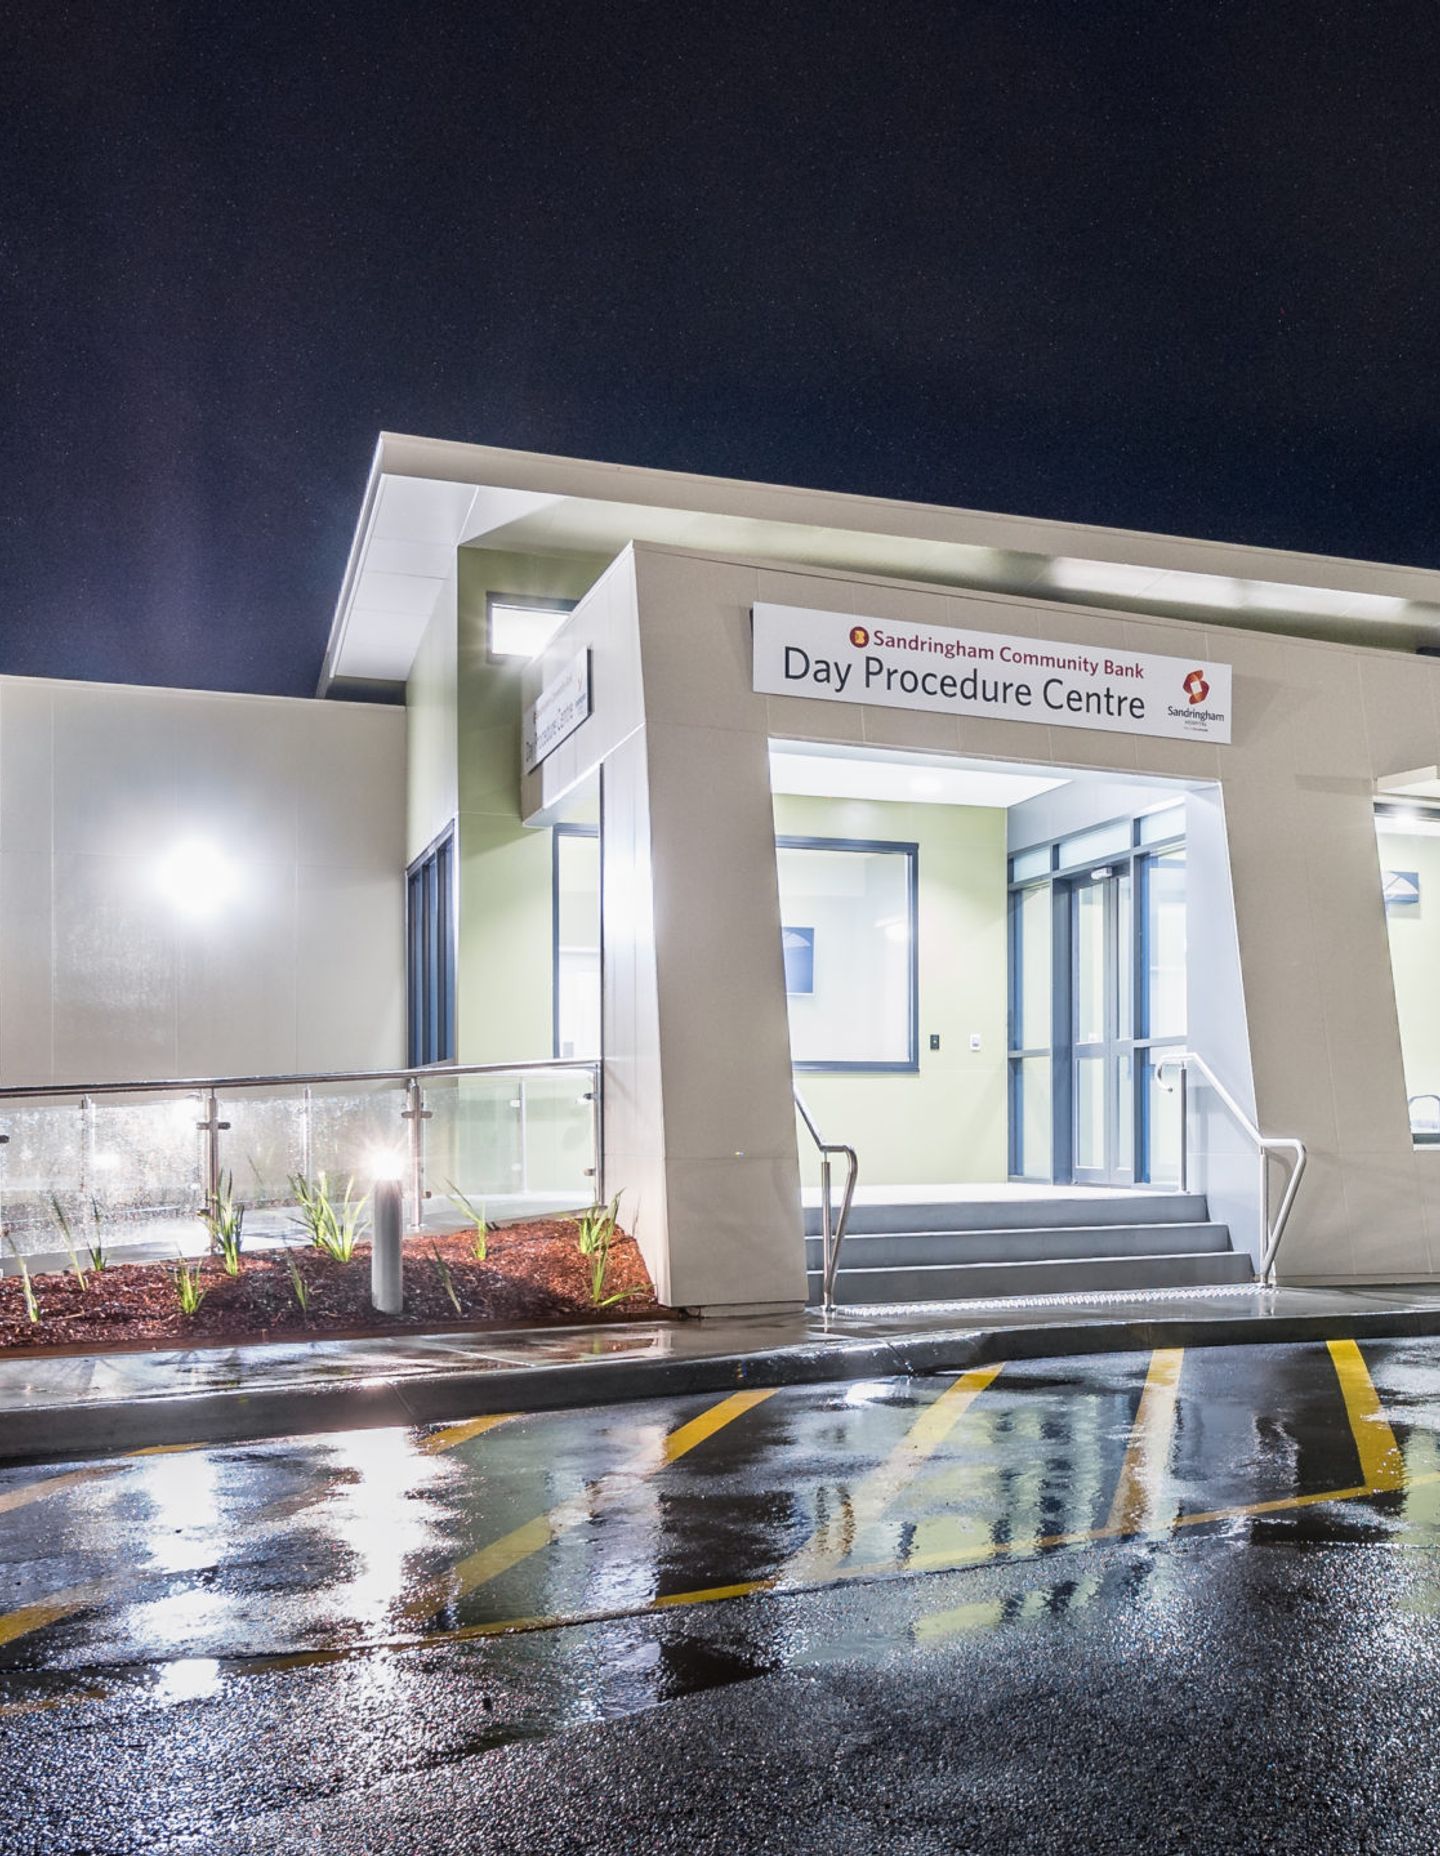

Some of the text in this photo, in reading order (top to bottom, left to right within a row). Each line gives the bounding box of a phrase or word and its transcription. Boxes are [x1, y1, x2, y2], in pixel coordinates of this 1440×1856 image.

[873, 629, 1145, 679] Sandringham Community Bank
[784, 645, 1146, 720] Day Procedure Centre
[1167, 705, 1225, 722] Sandringham
